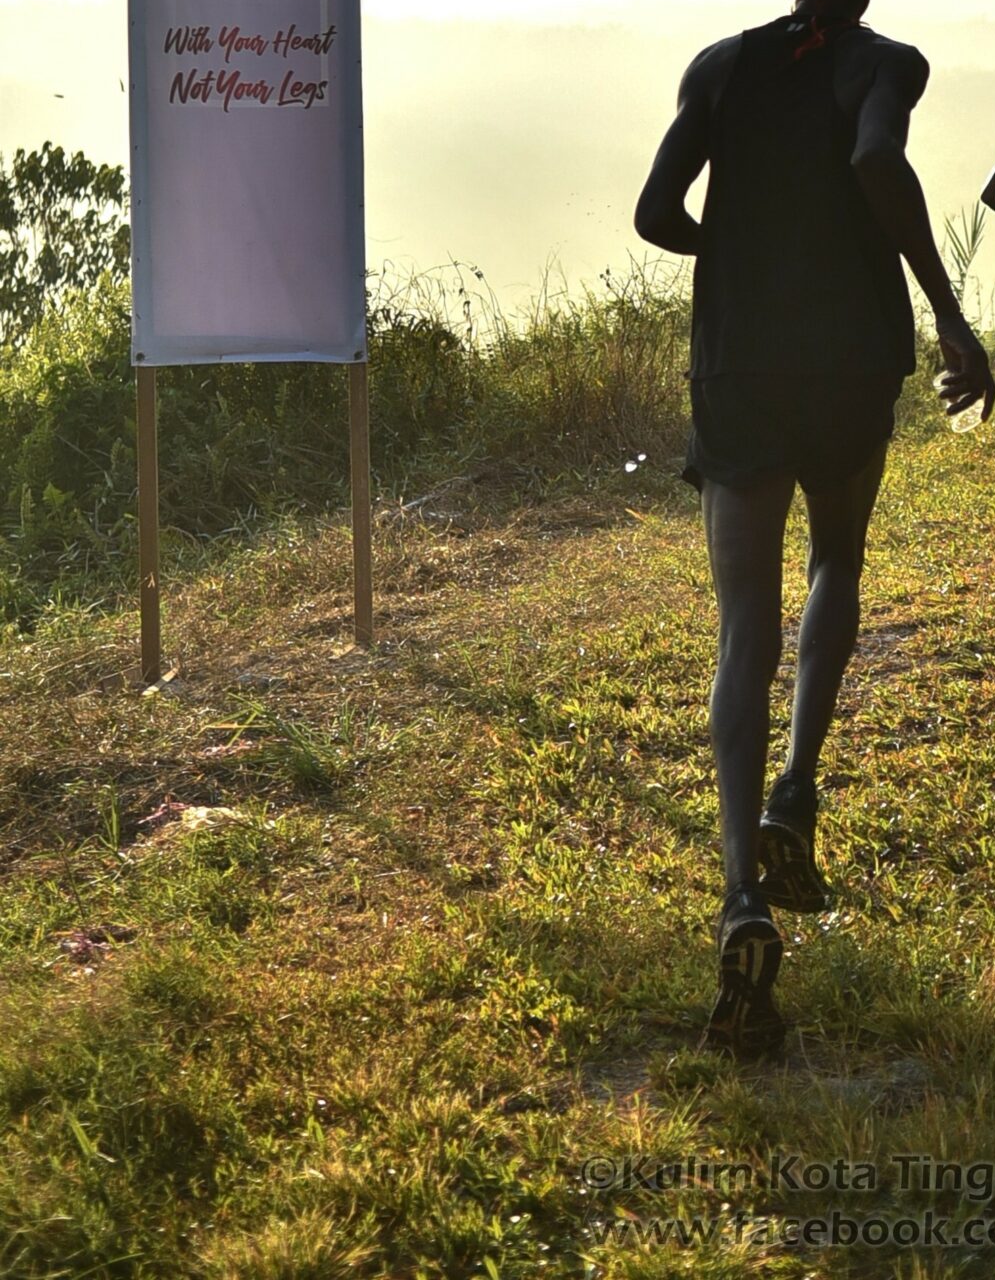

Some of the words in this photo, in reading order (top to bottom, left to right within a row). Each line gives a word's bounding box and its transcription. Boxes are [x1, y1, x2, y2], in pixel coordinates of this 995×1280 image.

[164, 26, 214, 55] With
[218, 26, 269, 64] Your
[273, 24, 337, 58] Heart
[169, 69, 216, 104] Not
[216, 70, 274, 113] Your
[277, 71, 328, 109] Legs
